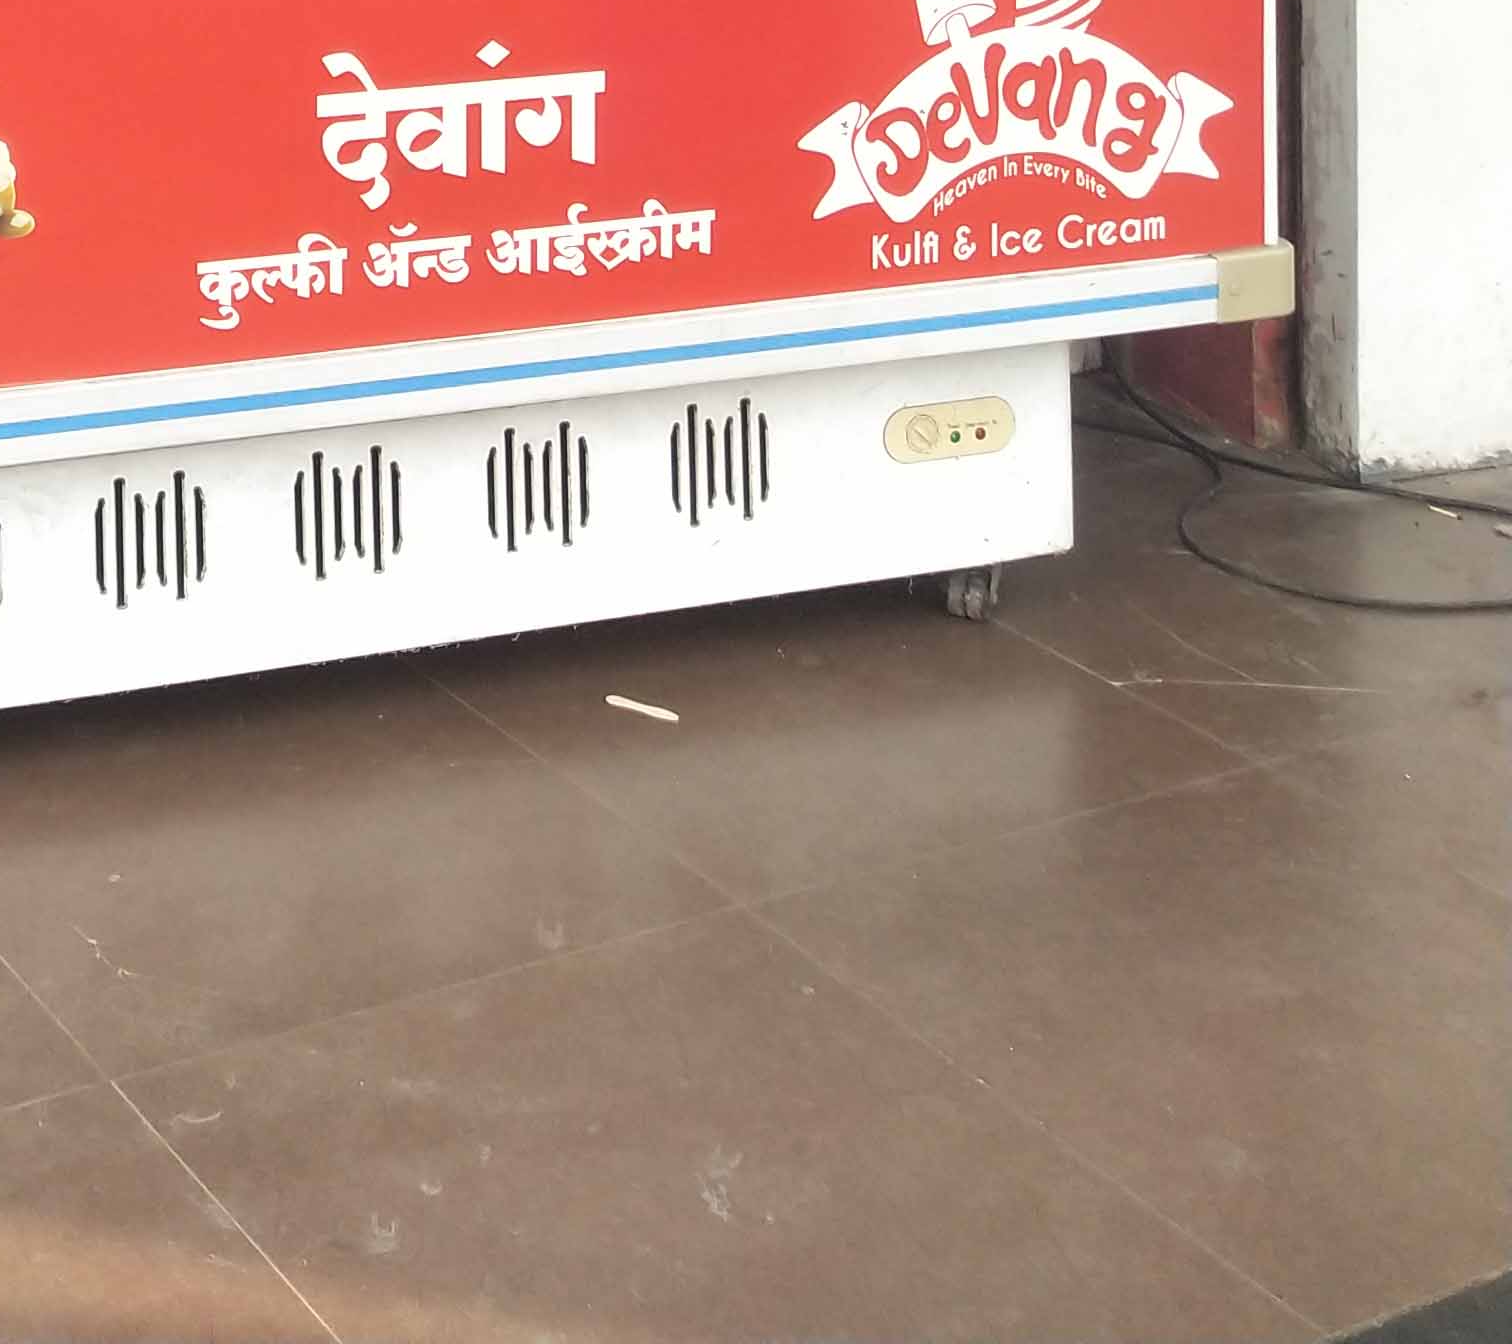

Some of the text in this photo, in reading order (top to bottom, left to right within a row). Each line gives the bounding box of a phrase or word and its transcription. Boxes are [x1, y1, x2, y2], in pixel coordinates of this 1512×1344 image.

[315, 39, 607, 210] देवांग
[933, 155, 1107, 217] Heaven In Every Bite
[196, 232, 348, 330] कुल्फी
[486, 198, 716, 277] आईस्क्रीम
[871, 214, 1167, 270] Kulfi & Ice Cream
